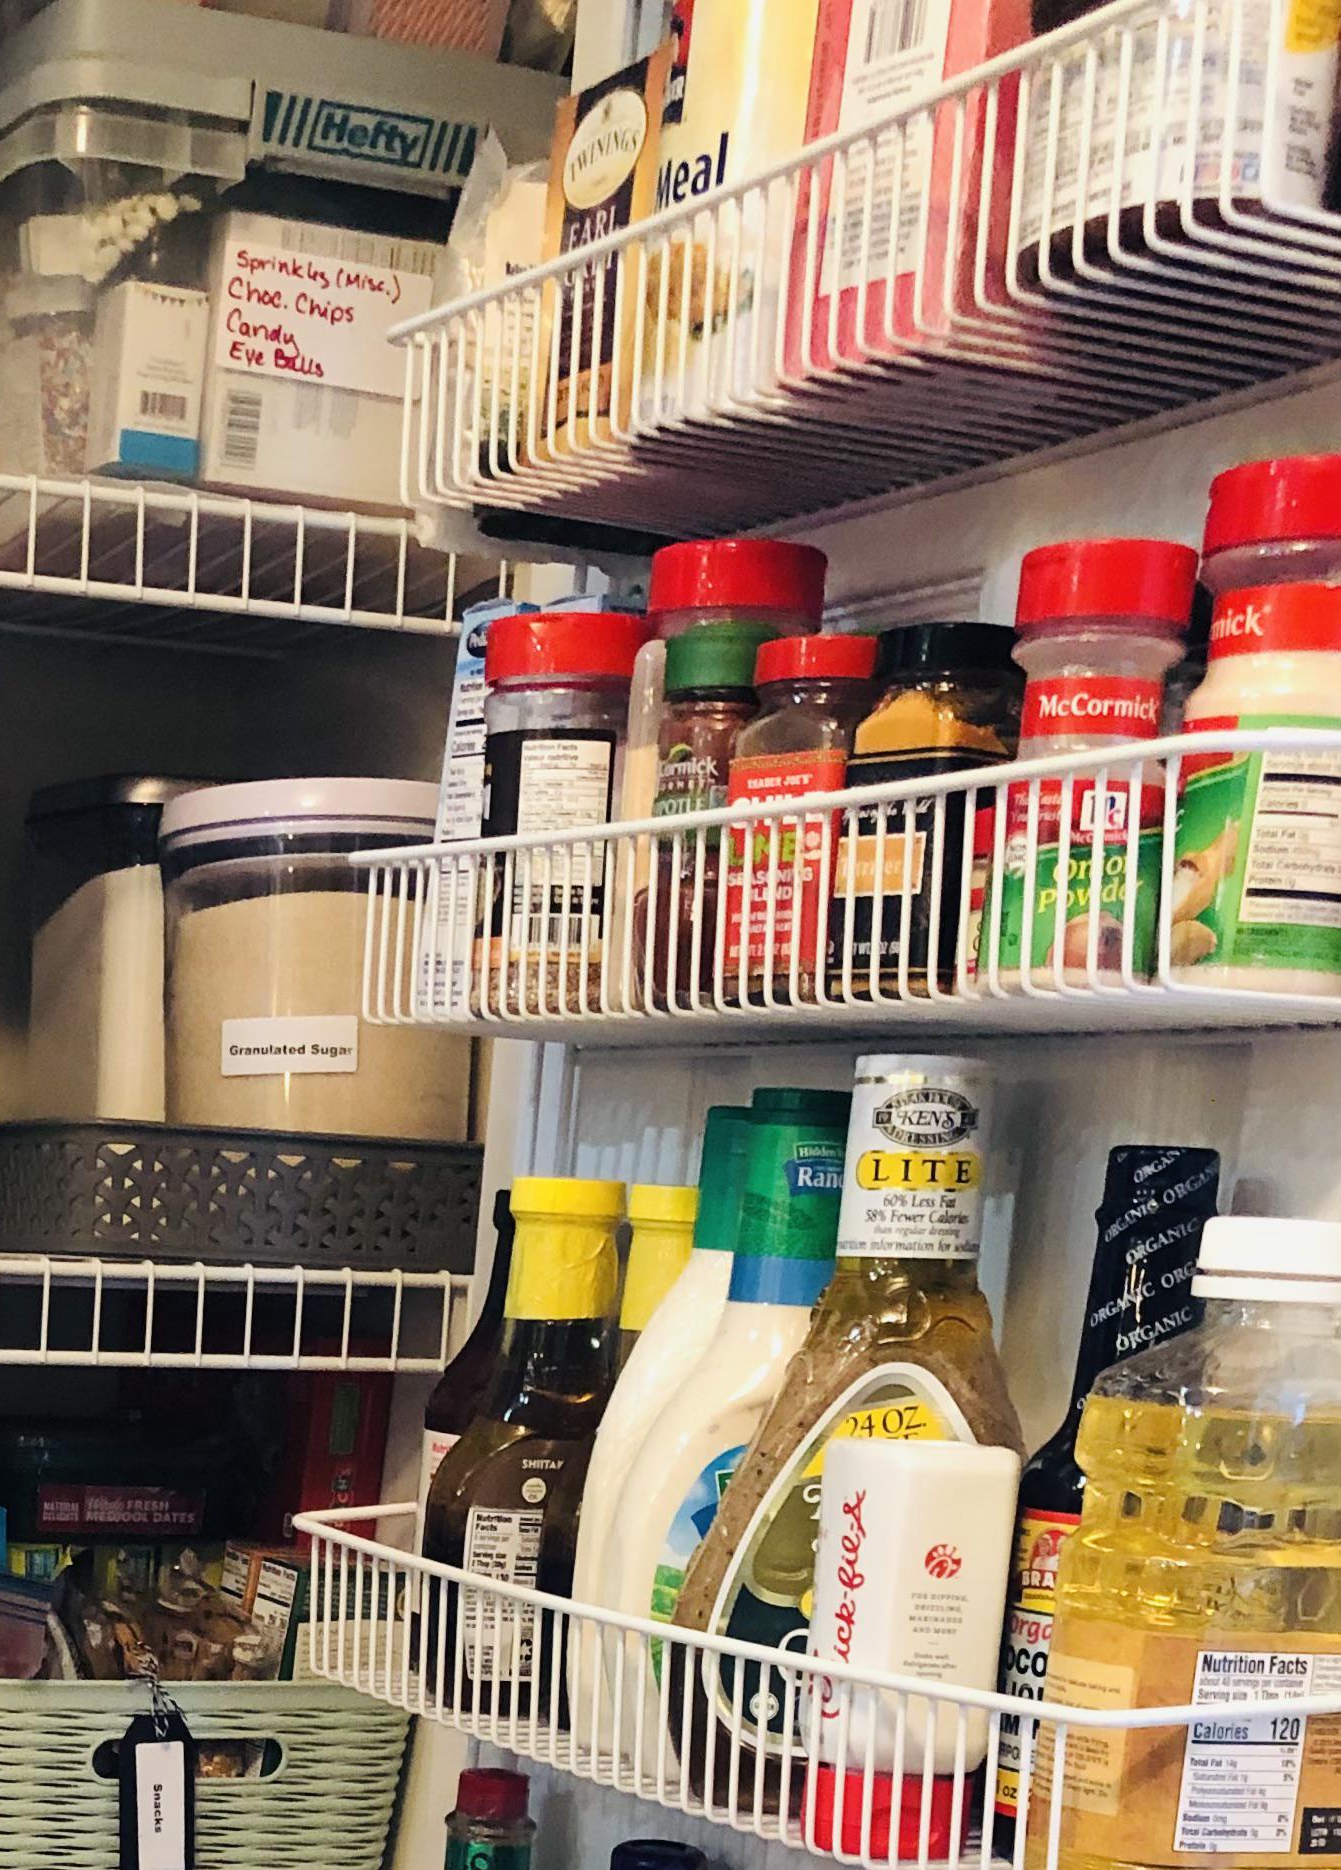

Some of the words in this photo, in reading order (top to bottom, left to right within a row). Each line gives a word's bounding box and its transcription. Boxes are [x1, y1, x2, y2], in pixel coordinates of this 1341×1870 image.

[321, 112, 421, 159] Hefty
[570, 130, 641, 182] TWININGS
[336, 267, 402, 305] (Misc.)
[227, 275, 288, 310] Choc.
[295, 293, 355, 326] Chips
[225, 307, 300, 357] Candy
[228, 341, 265, 366] Eye
[273, 347, 325, 378] Balls
[1038, 692, 1159, 724] McCormick
[228, 1043, 306, 1058] Granulated
[311, 1043, 354, 1060] Sugar
[872, 1158, 972, 1184] LITE
[883, 1195, 908, 1207] 60%
[911, 1195, 936, 1207] Less
[939, 1197, 957, 1209] Fat
[864, 1209, 887, 1222] 58%
[890, 1209, 924, 1223] Fewer
[928, 1210, 970, 1225] Calories
[870, 1240, 936, 1252] information
[1125, 1216, 1200, 1265] ORGANIC
[1115, 1305, 1194, 1352] ORGANIC
[125, 1499, 170, 1512] FRESH
[153, 1511, 196, 1525] DATES
[474, 1523, 499, 1532] Facts
[476, 1513, 513, 1524] Nutrition
[912, 1626, 930, 1635] AND
[932, 1627, 957, 1636] MORE
[1201, 1653, 1265, 1674] Nutrition
[1268, 1655, 1309, 1675] Facts
[1197, 1688, 1230, 1701] Serving
[1193, 1722, 1249, 1740] Calories
[1270, 1717, 1301, 1741] 120
[1189, 1758, 1209, 1768] Total
[1210, 1758, 1223, 1768] Fat
[151, 1783, 164, 1835] Snacks
[1181, 1827, 1200, 1837] Total
[1201, 1828, 1248, 1838] Carbohydrate
